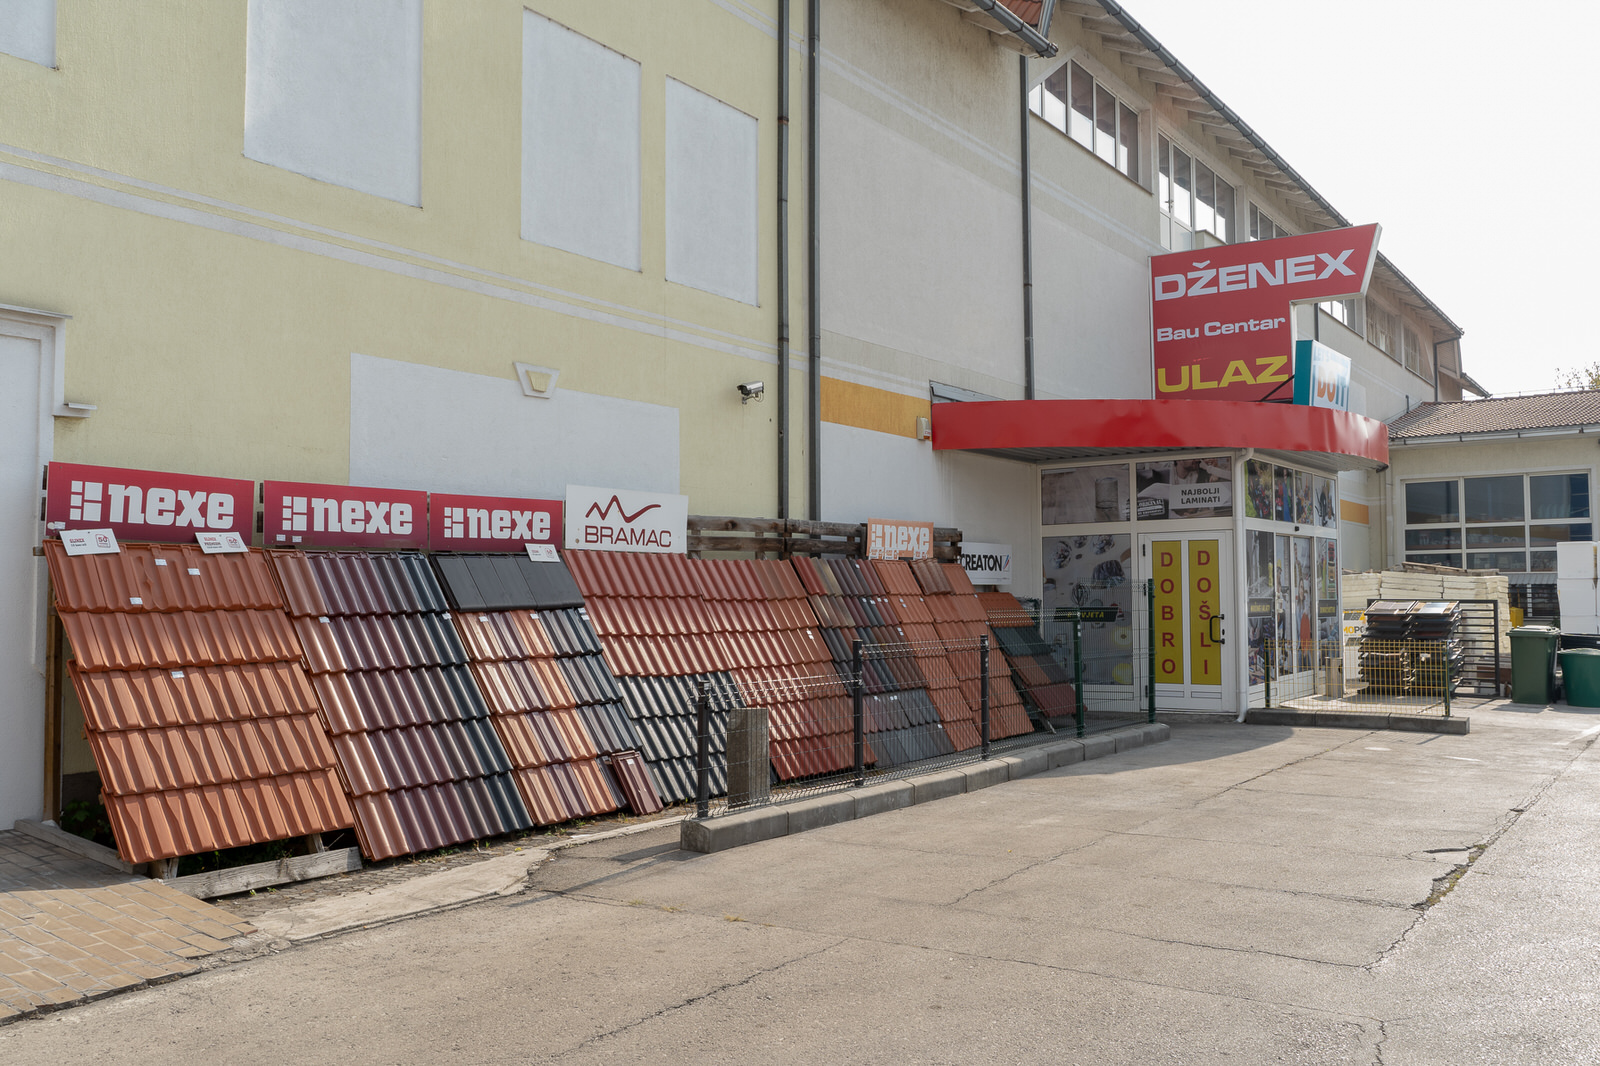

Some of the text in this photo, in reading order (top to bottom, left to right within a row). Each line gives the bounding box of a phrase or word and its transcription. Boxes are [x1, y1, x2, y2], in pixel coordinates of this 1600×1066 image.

[1154, 248, 1356, 301] DŽENEX
[1157, 317, 1286, 342] Bau Centar
[1157, 355, 1290, 393] ULAZ
[108, 484, 234, 529] nexe
[1181, 487, 1220, 496] NAJBOLJI
[1181, 496, 1221, 505] LAMINATI
[311, 497, 413, 534] nexe
[467, 508, 551, 540] nexe
[585, 525, 672, 548] BRAMAC
[884, 524, 930, 551] nexe
[1160, 552, 1176, 674] DOBRO
[1197, 550, 1212, 675] DOŠLI
